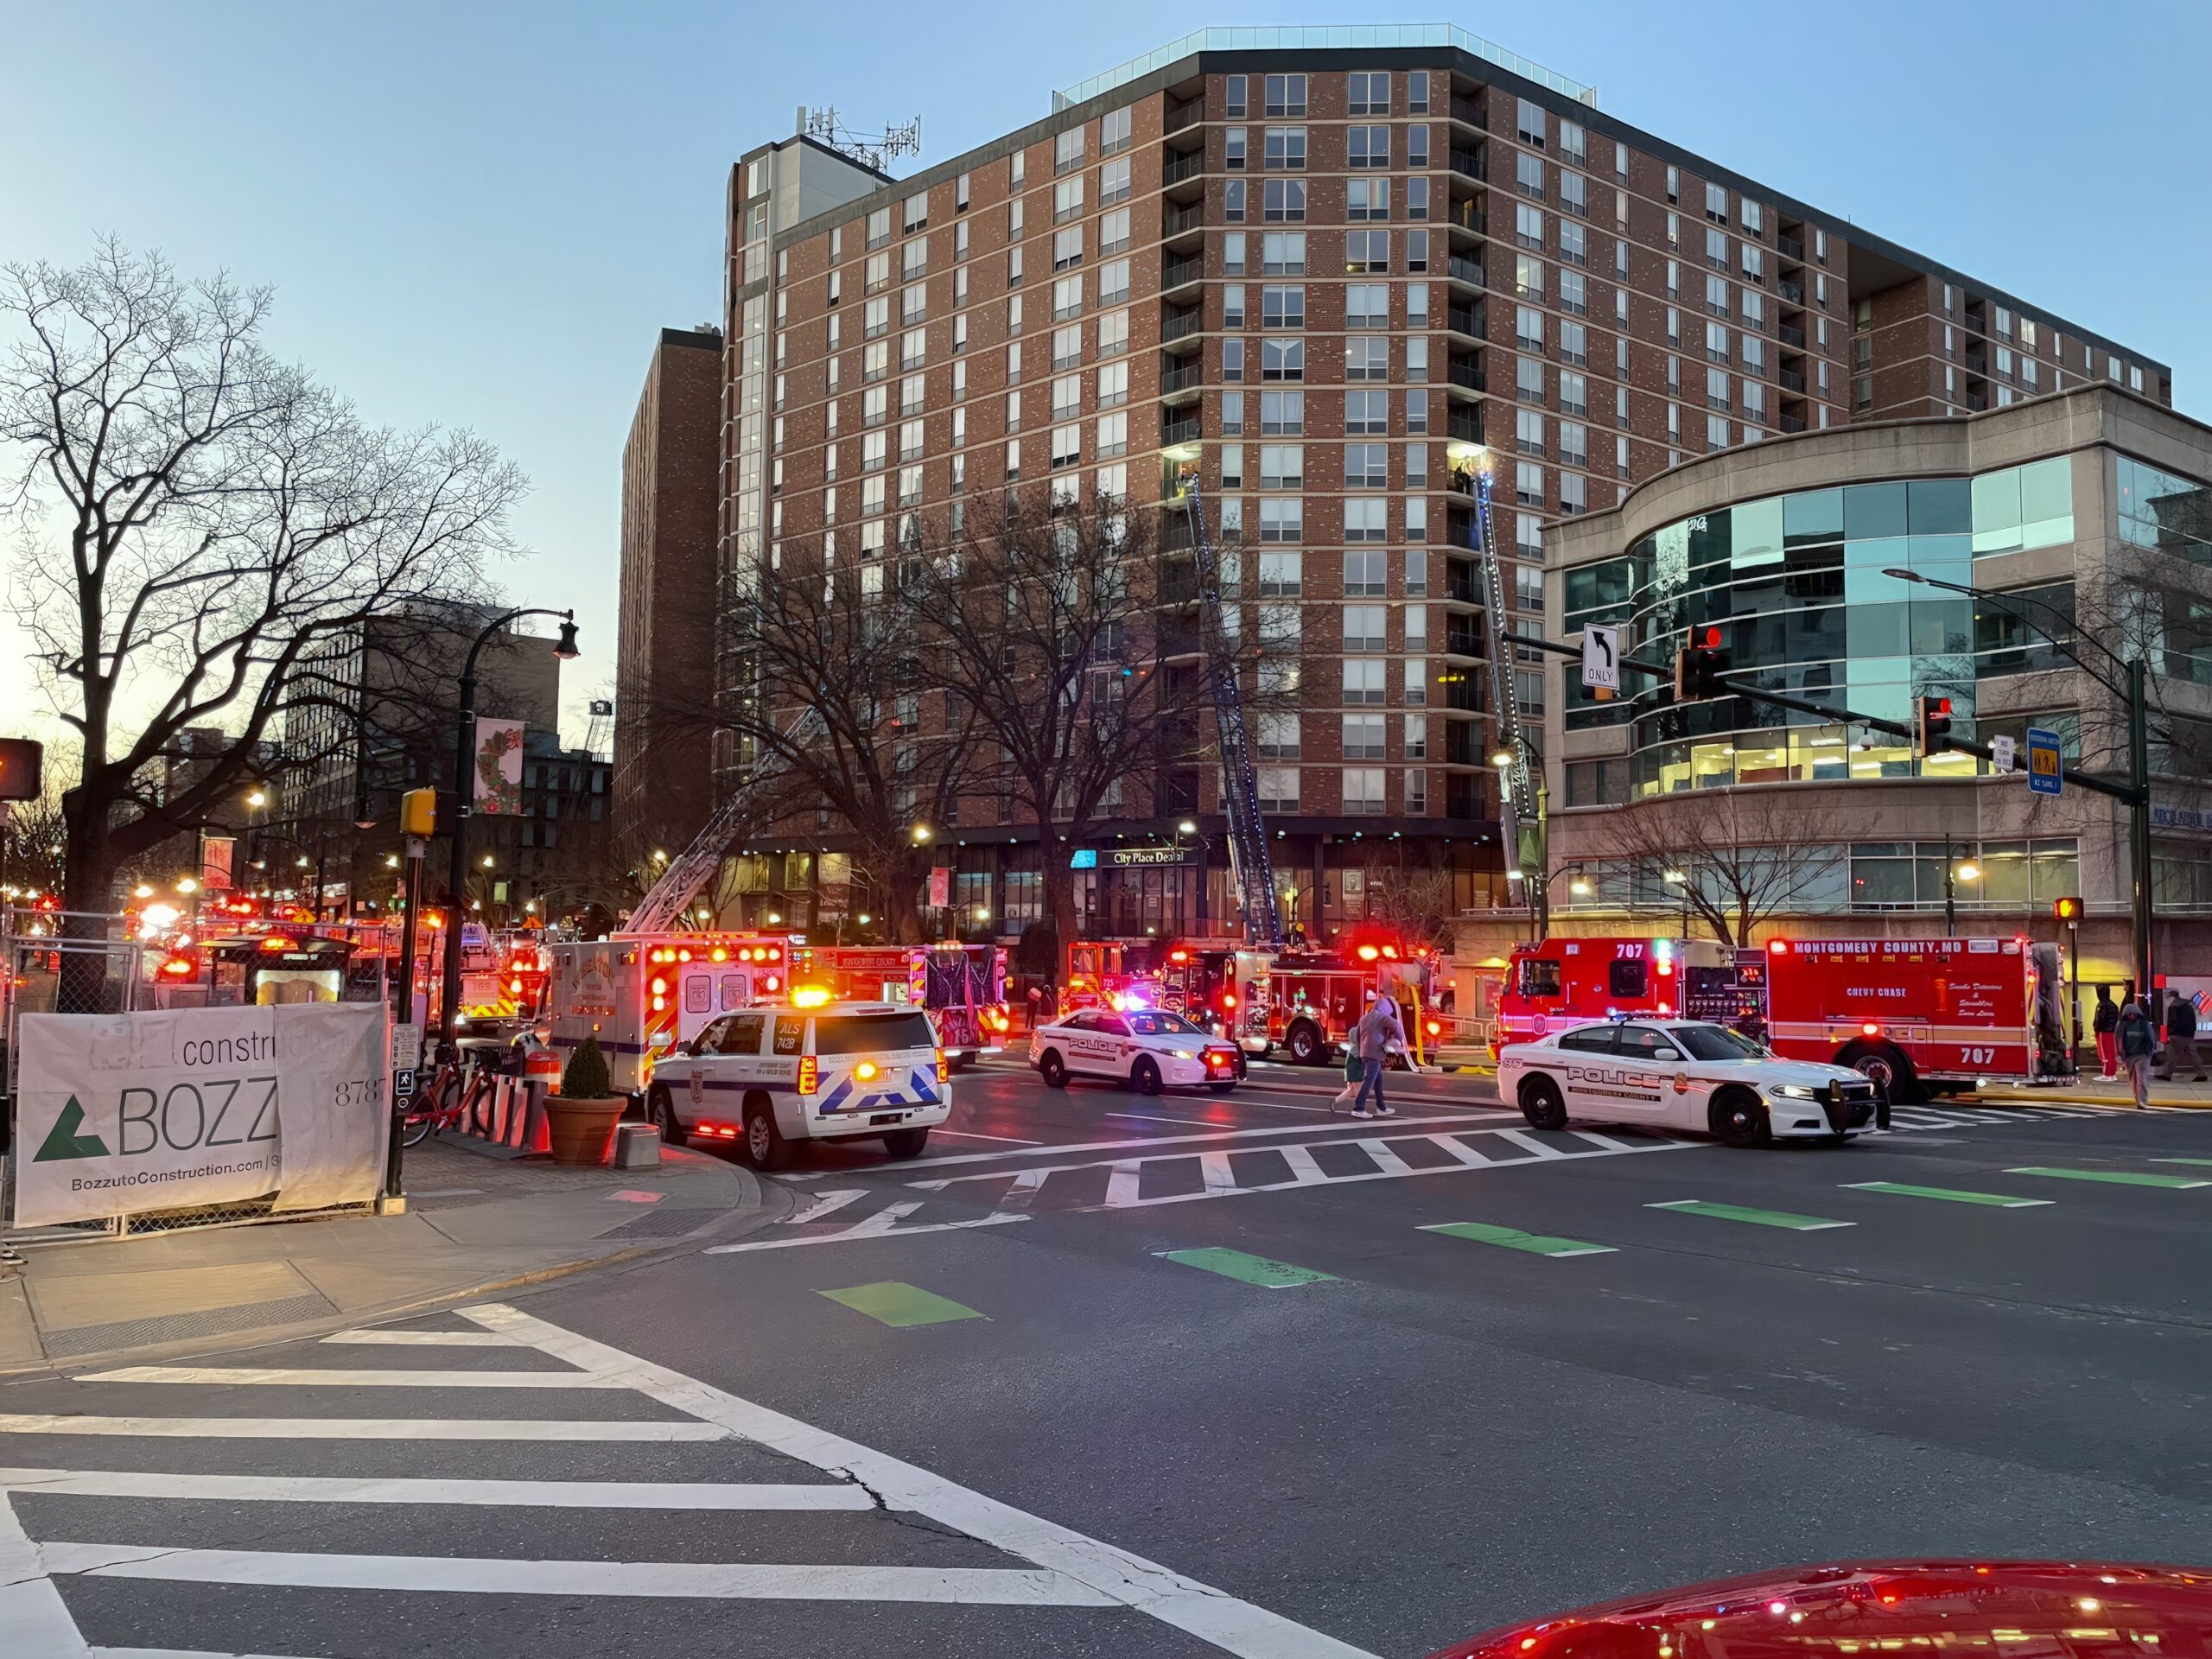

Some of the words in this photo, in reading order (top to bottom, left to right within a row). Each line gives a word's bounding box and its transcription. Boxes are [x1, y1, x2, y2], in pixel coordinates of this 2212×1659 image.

[1589, 668, 1613, 683] ONLY
[1114, 853, 1131, 866] City
[1133, 852, 1154, 863] Place
[1155, 851, 1184, 863] Denal
[1617, 944, 1643, 958] 707
[1794, 941, 1878, 954] MONTGOMERY
[1942, 941, 1962, 953] MD
[1847, 988, 1874, 997] CHEVY
[1878, 988, 1906, 997] CHASE
[1069, 1038, 1117, 1052] POLICE
[1961, 1047, 1995, 1064] 707
[1567, 1066, 1661, 1089] POLICE
[72, 1160, 263, 1191] BozzutoConstruction.com
